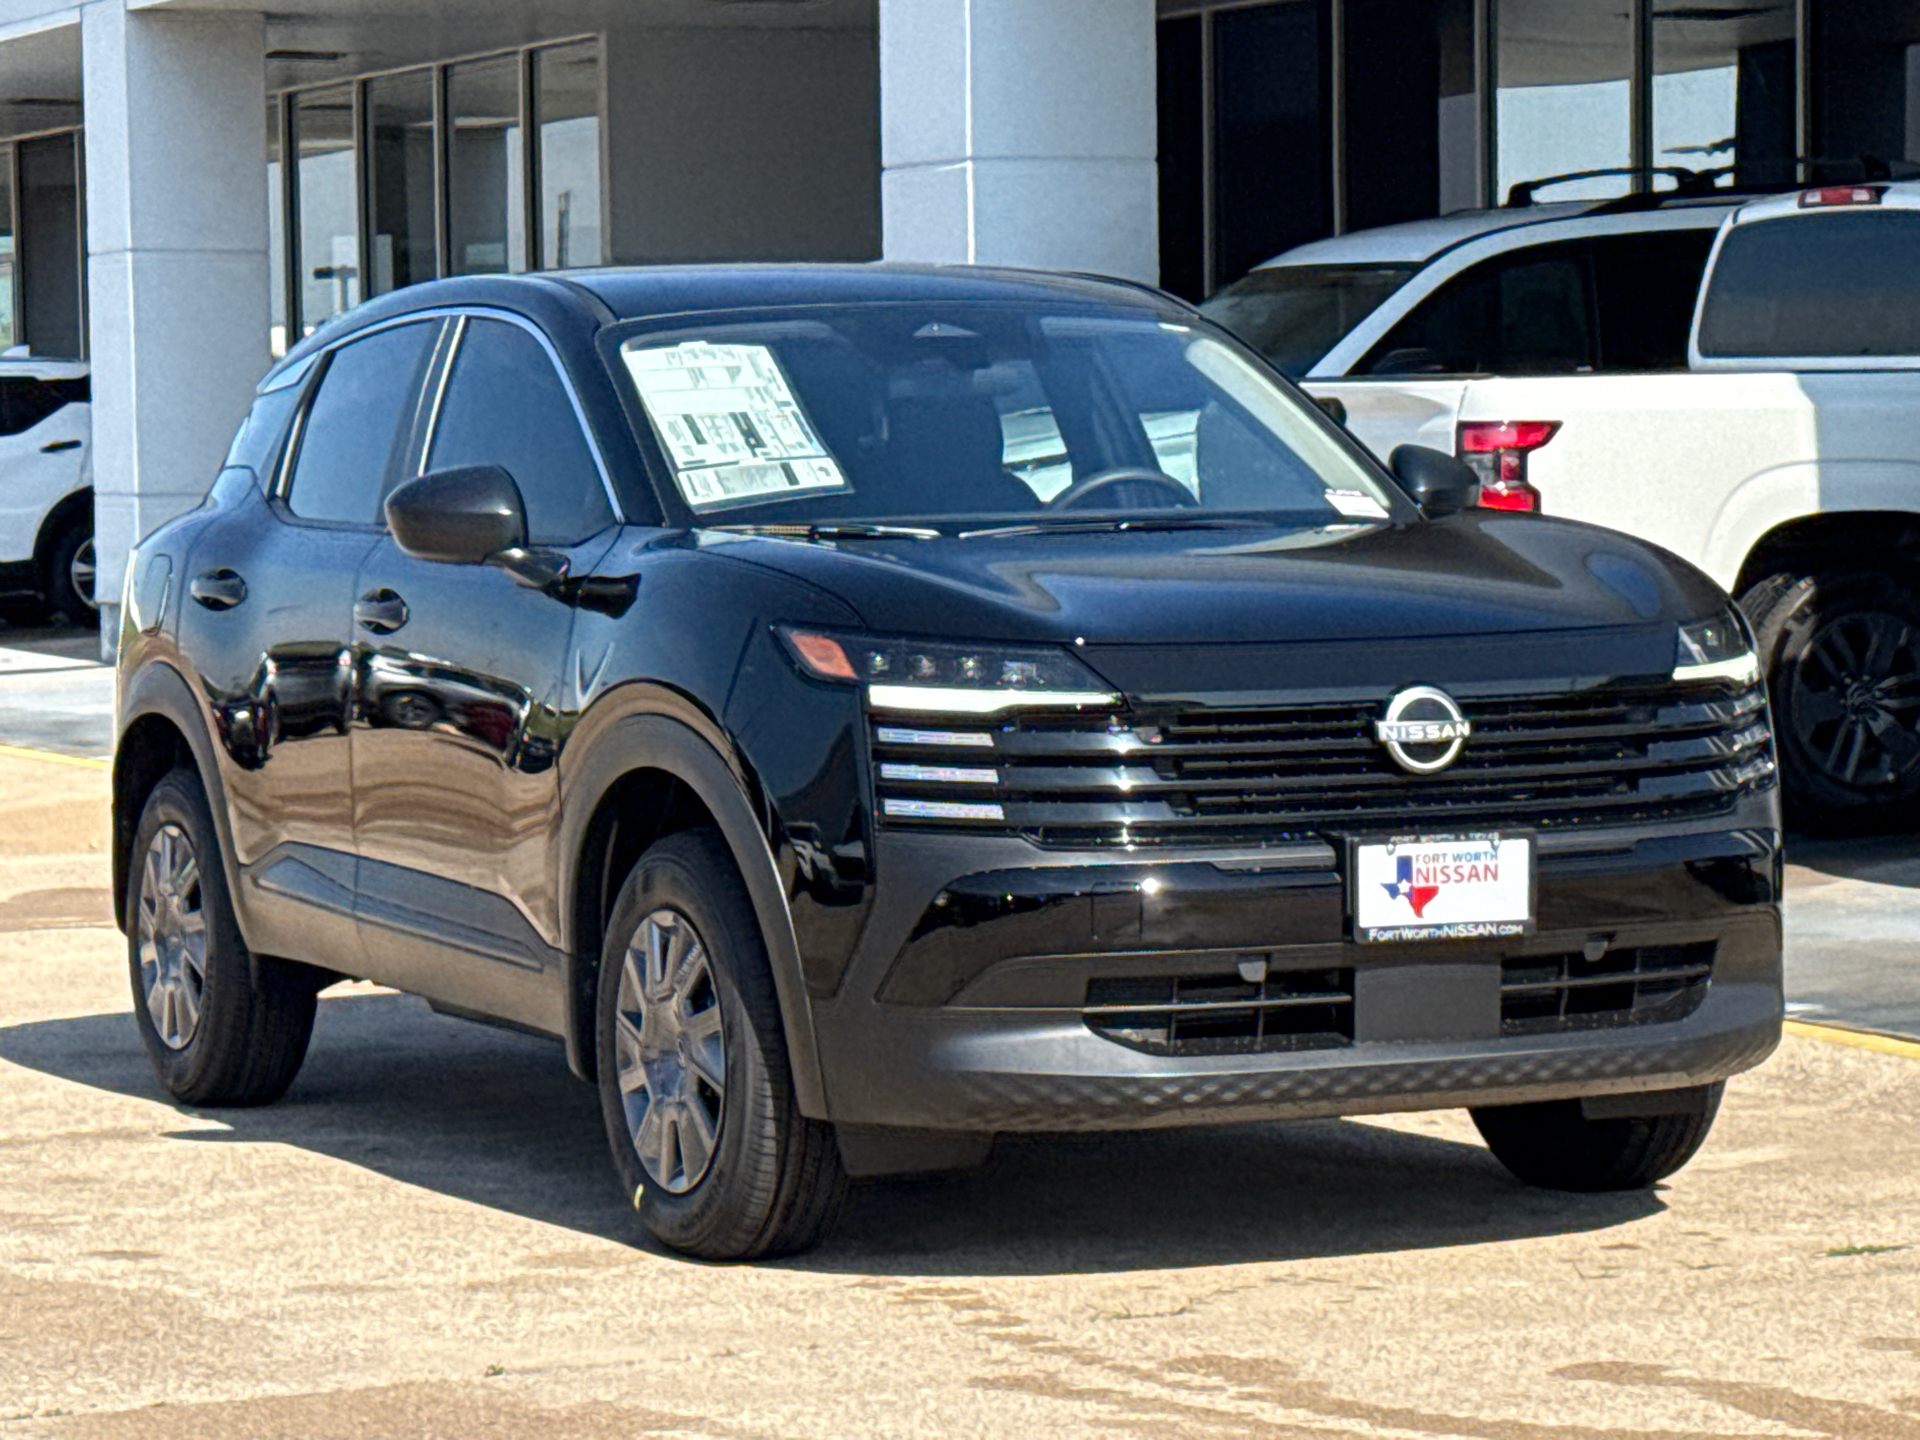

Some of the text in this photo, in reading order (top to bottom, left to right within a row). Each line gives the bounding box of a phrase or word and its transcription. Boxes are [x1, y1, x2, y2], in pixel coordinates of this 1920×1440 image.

[1381, 721, 1471, 740] NISSAN
[1415, 851, 1499, 864] FORT WORTH
[1415, 863, 1499, 885] NISSAN
